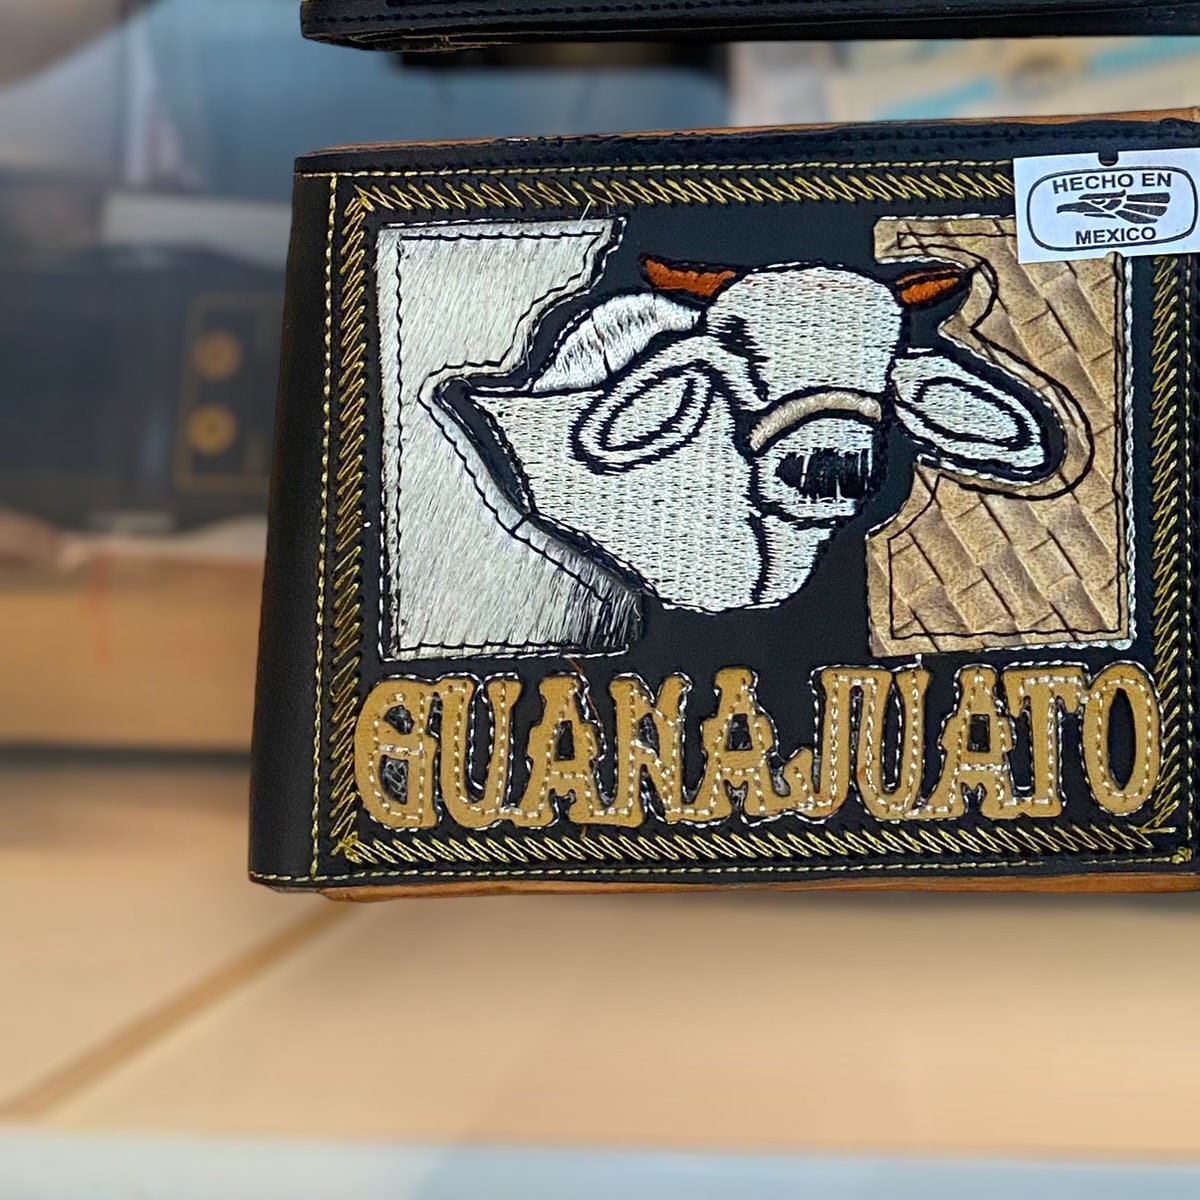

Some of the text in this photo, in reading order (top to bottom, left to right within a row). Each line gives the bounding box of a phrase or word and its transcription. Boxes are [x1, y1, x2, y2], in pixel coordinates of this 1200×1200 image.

[1052, 172, 1172, 194] HECHO EN
[1075, 226, 1156, 245] MEXICO
[353, 662, 1163, 831] GUANAJUATO
